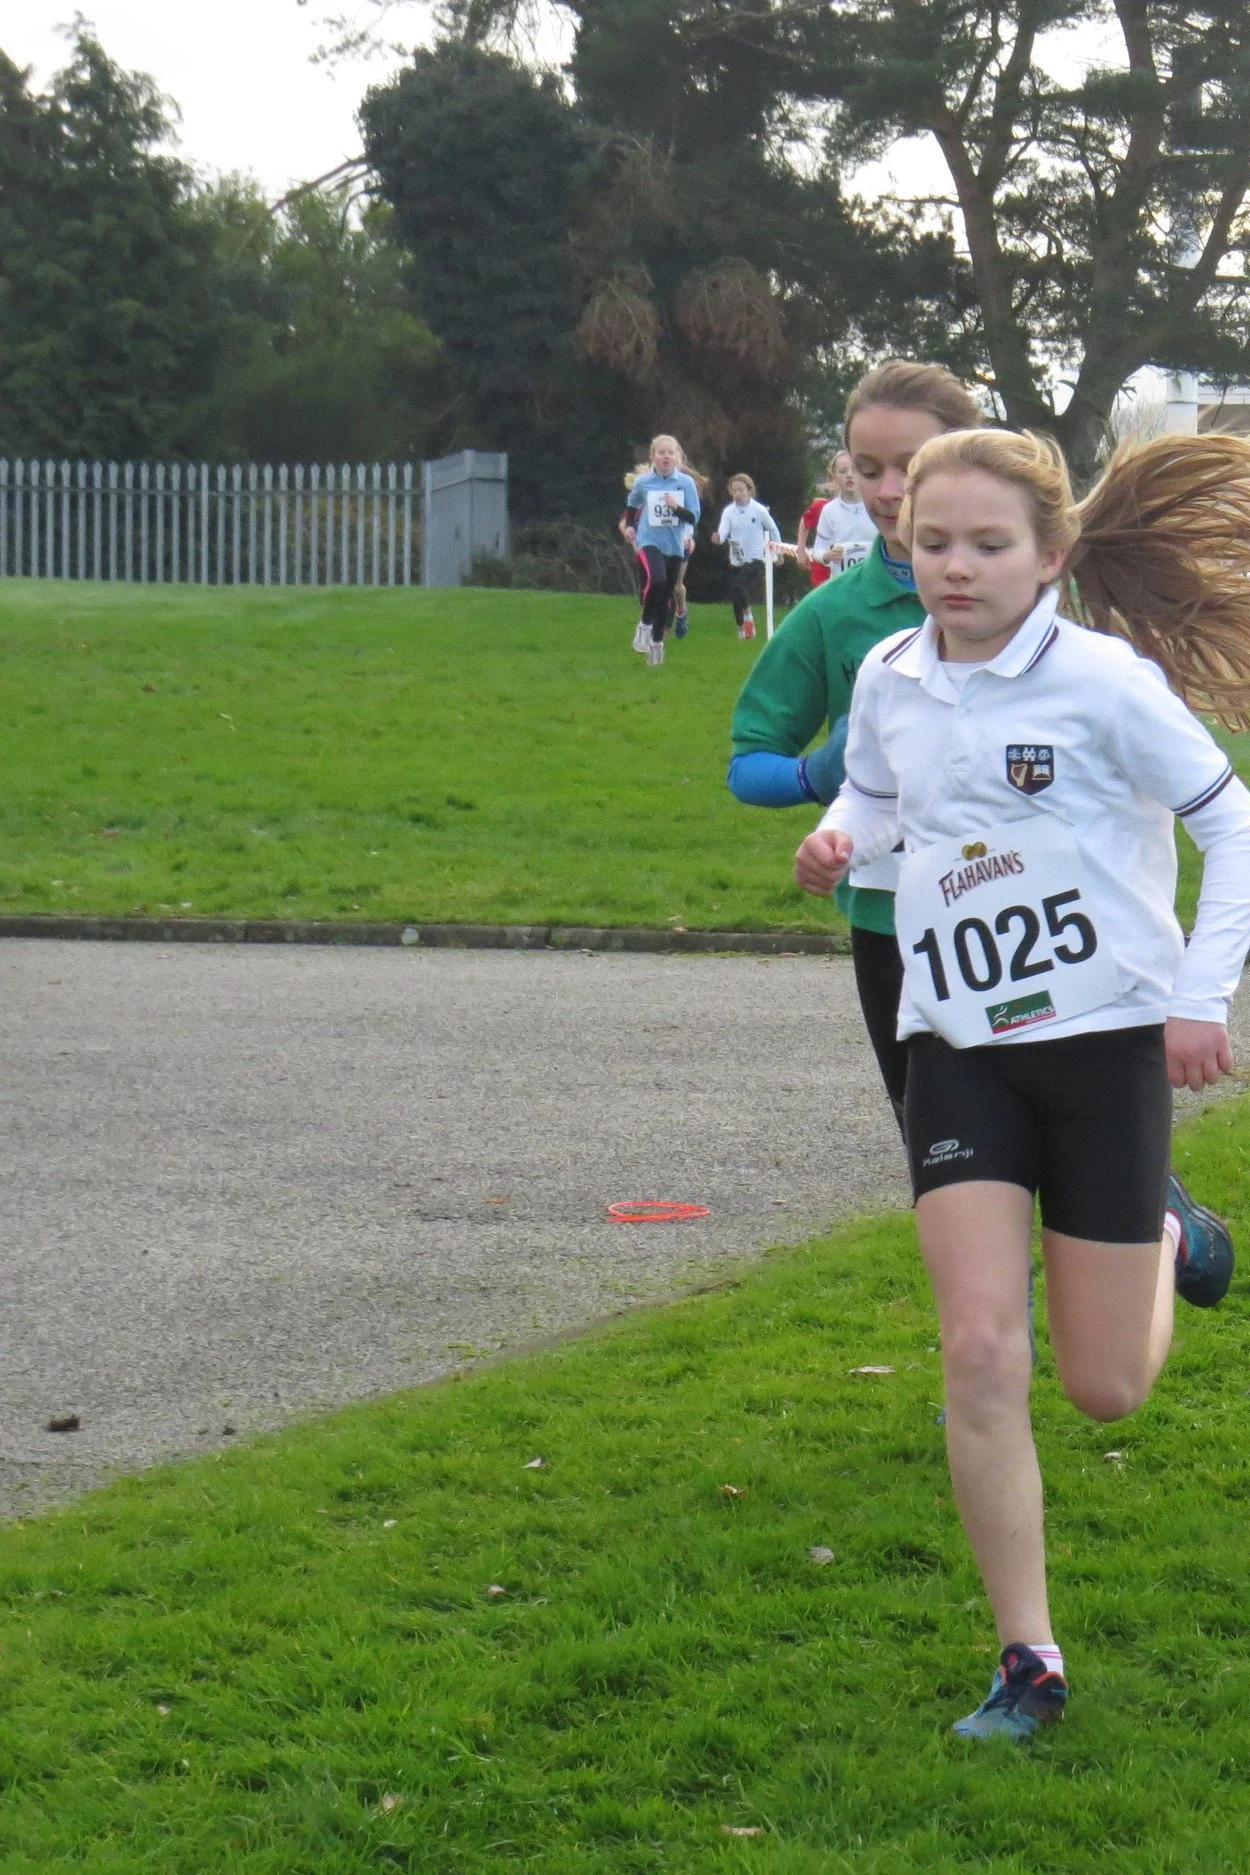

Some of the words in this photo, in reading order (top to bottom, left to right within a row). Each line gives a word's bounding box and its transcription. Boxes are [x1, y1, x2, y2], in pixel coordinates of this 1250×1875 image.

[654, 505, 676, 517] 93
[938, 850, 1024, 908] FLAHAVAN'S
[912, 888, 1098, 1002] 1025
